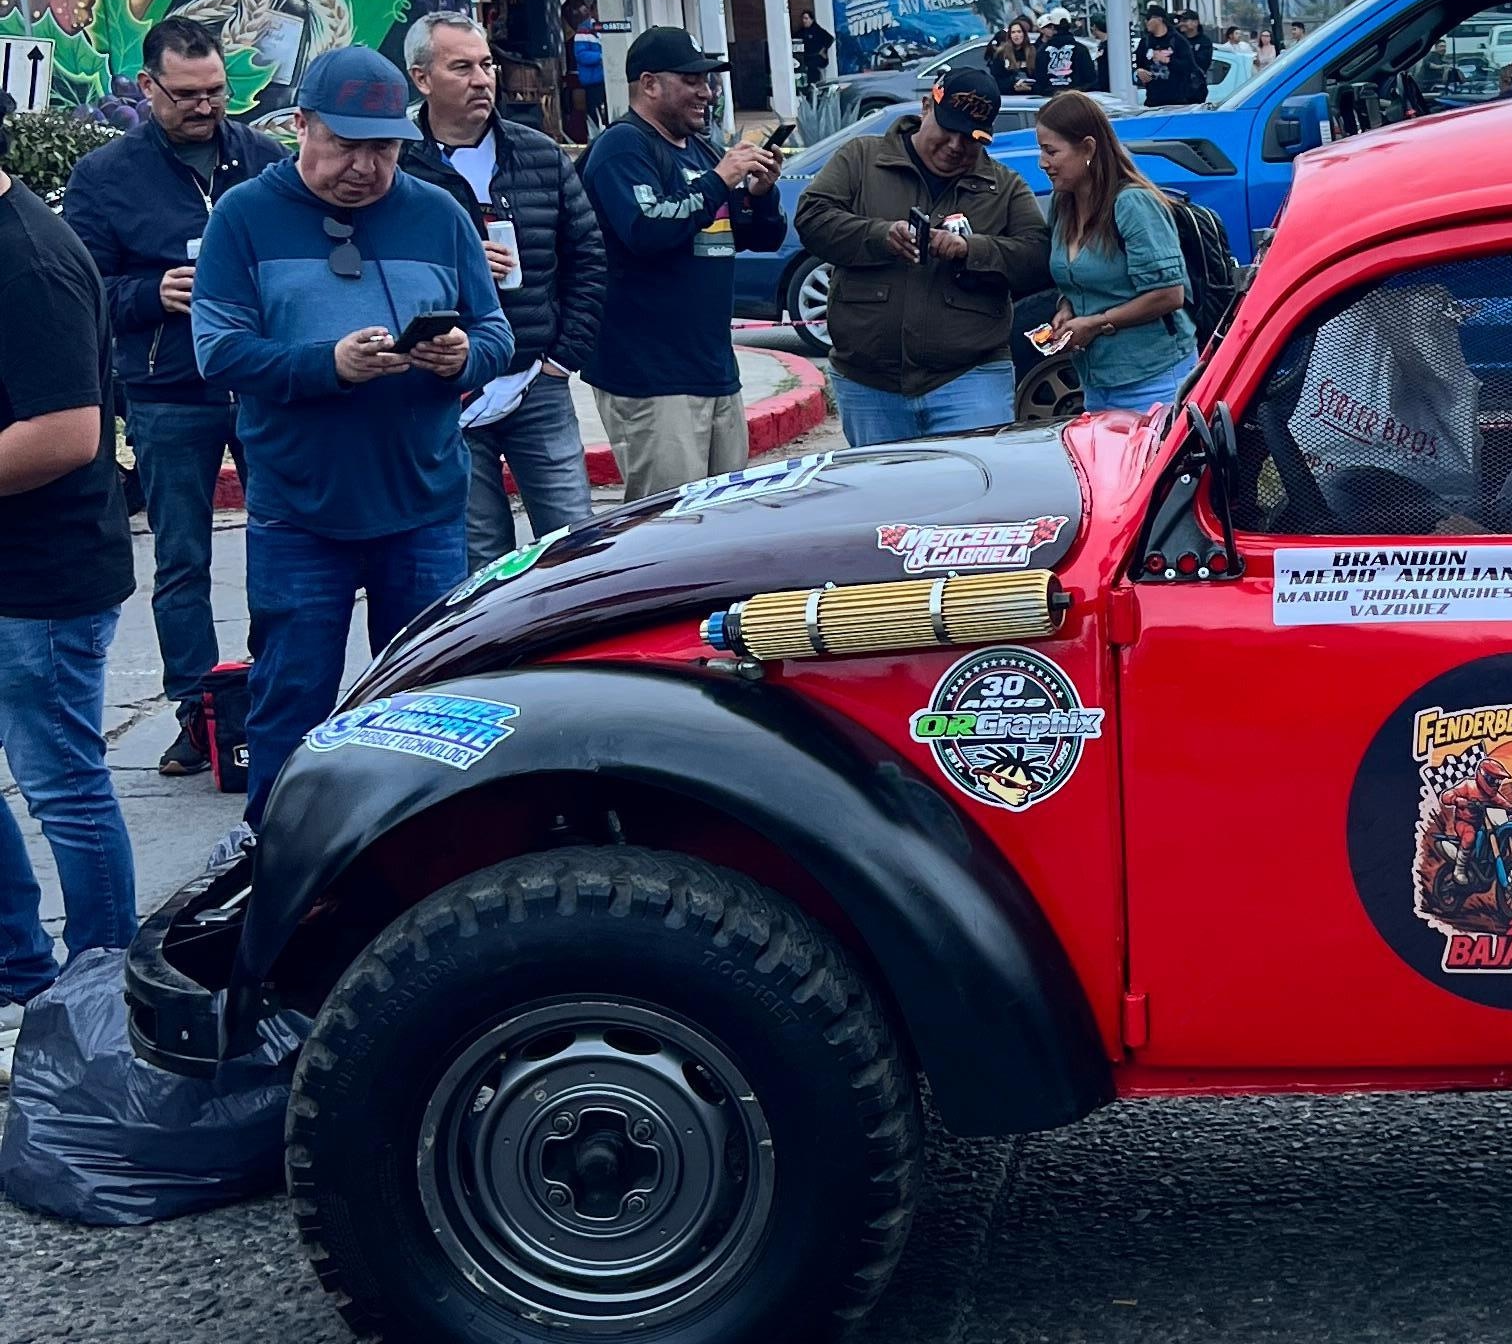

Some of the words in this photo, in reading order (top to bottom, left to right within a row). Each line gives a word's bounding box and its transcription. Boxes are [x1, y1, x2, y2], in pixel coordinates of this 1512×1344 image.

[897, 524, 1039, 550] MERCEDES
[1332, 550, 1467, 567] BRANDON
[1277, 590, 1349, 603] MARIO
[1350, 602, 1450, 617] VAZQUEZ
[980, 675, 1026, 697] 30
[402, 696, 516, 725] AGUNDEZ
[960, 697, 1047, 708] AÑOS
[367, 710, 505, 749] KONGCRETE
[356, 730, 398, 748] PEBBLE
[398, 735, 479, 766] TECHNOLOGY
